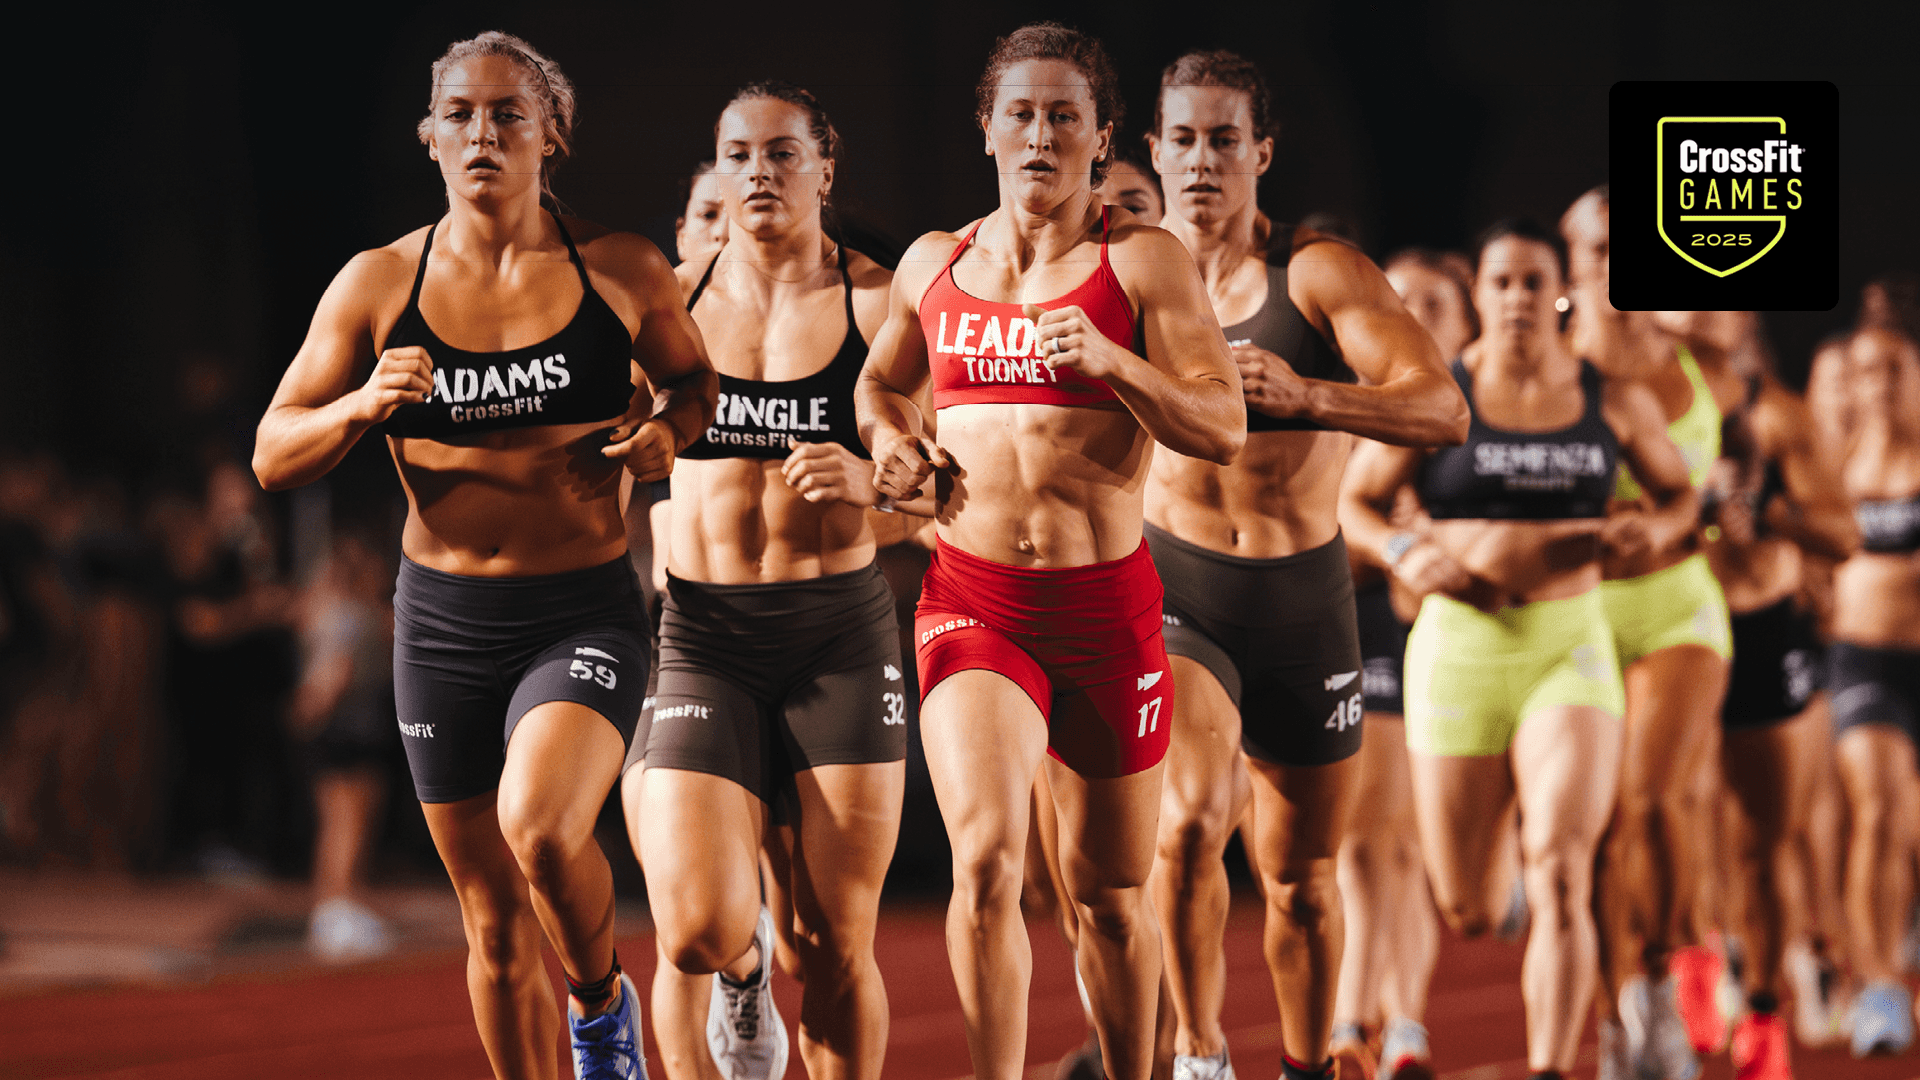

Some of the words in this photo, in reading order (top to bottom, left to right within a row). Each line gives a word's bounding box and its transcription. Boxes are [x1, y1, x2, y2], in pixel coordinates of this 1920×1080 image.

[433, 353, 570, 403] ADAMS
[963, 357, 1057, 383] TOOMEY
[451, 396, 543, 422] CrossFit
[569, 659, 617, 690] 59
[882, 692, 905, 725] 32
[1138, 697, 1162, 738] 17
[1324, 692, 1362, 732] 46
